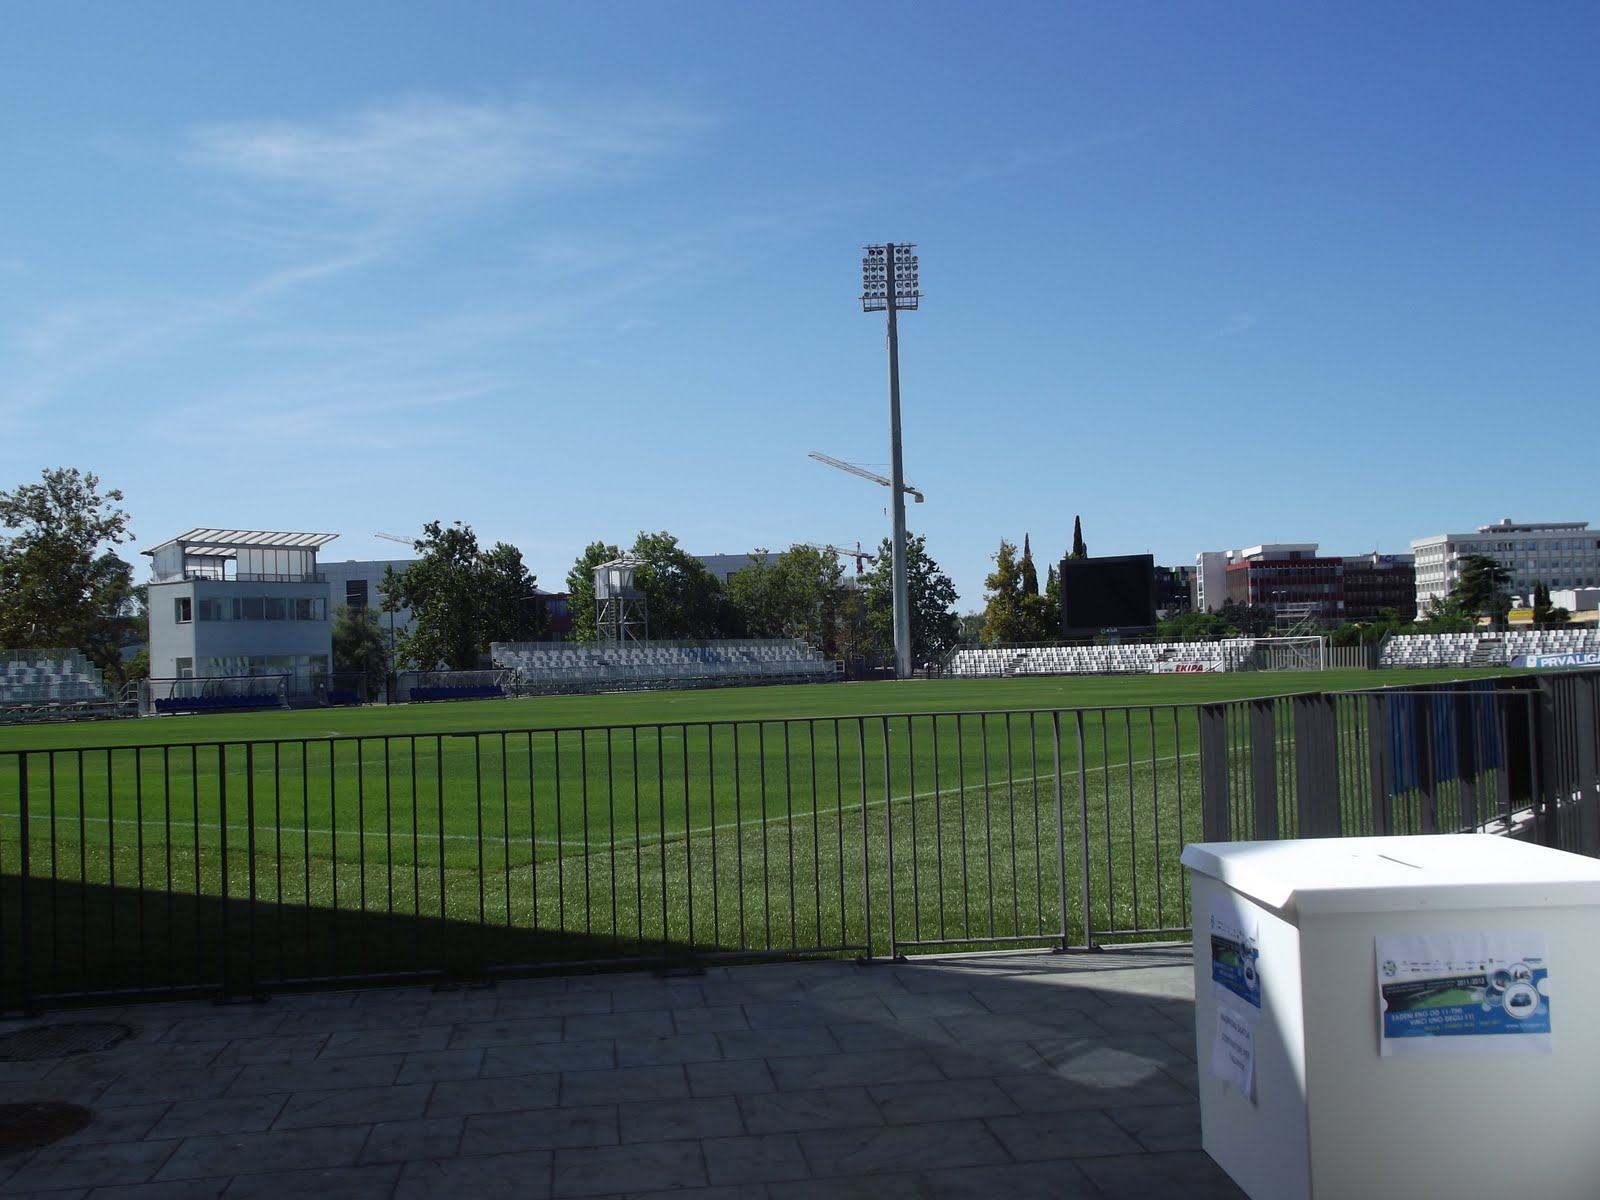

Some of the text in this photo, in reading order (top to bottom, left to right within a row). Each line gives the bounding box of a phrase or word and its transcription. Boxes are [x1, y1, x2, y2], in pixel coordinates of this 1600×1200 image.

[1174, 663, 1203, 673] EKIPA
[1409, 1017, 1427, 1025] VINCI
[1428, 1016, 1444, 1024] UNO
[1445, 1014, 1463, 1022] DEGLI
